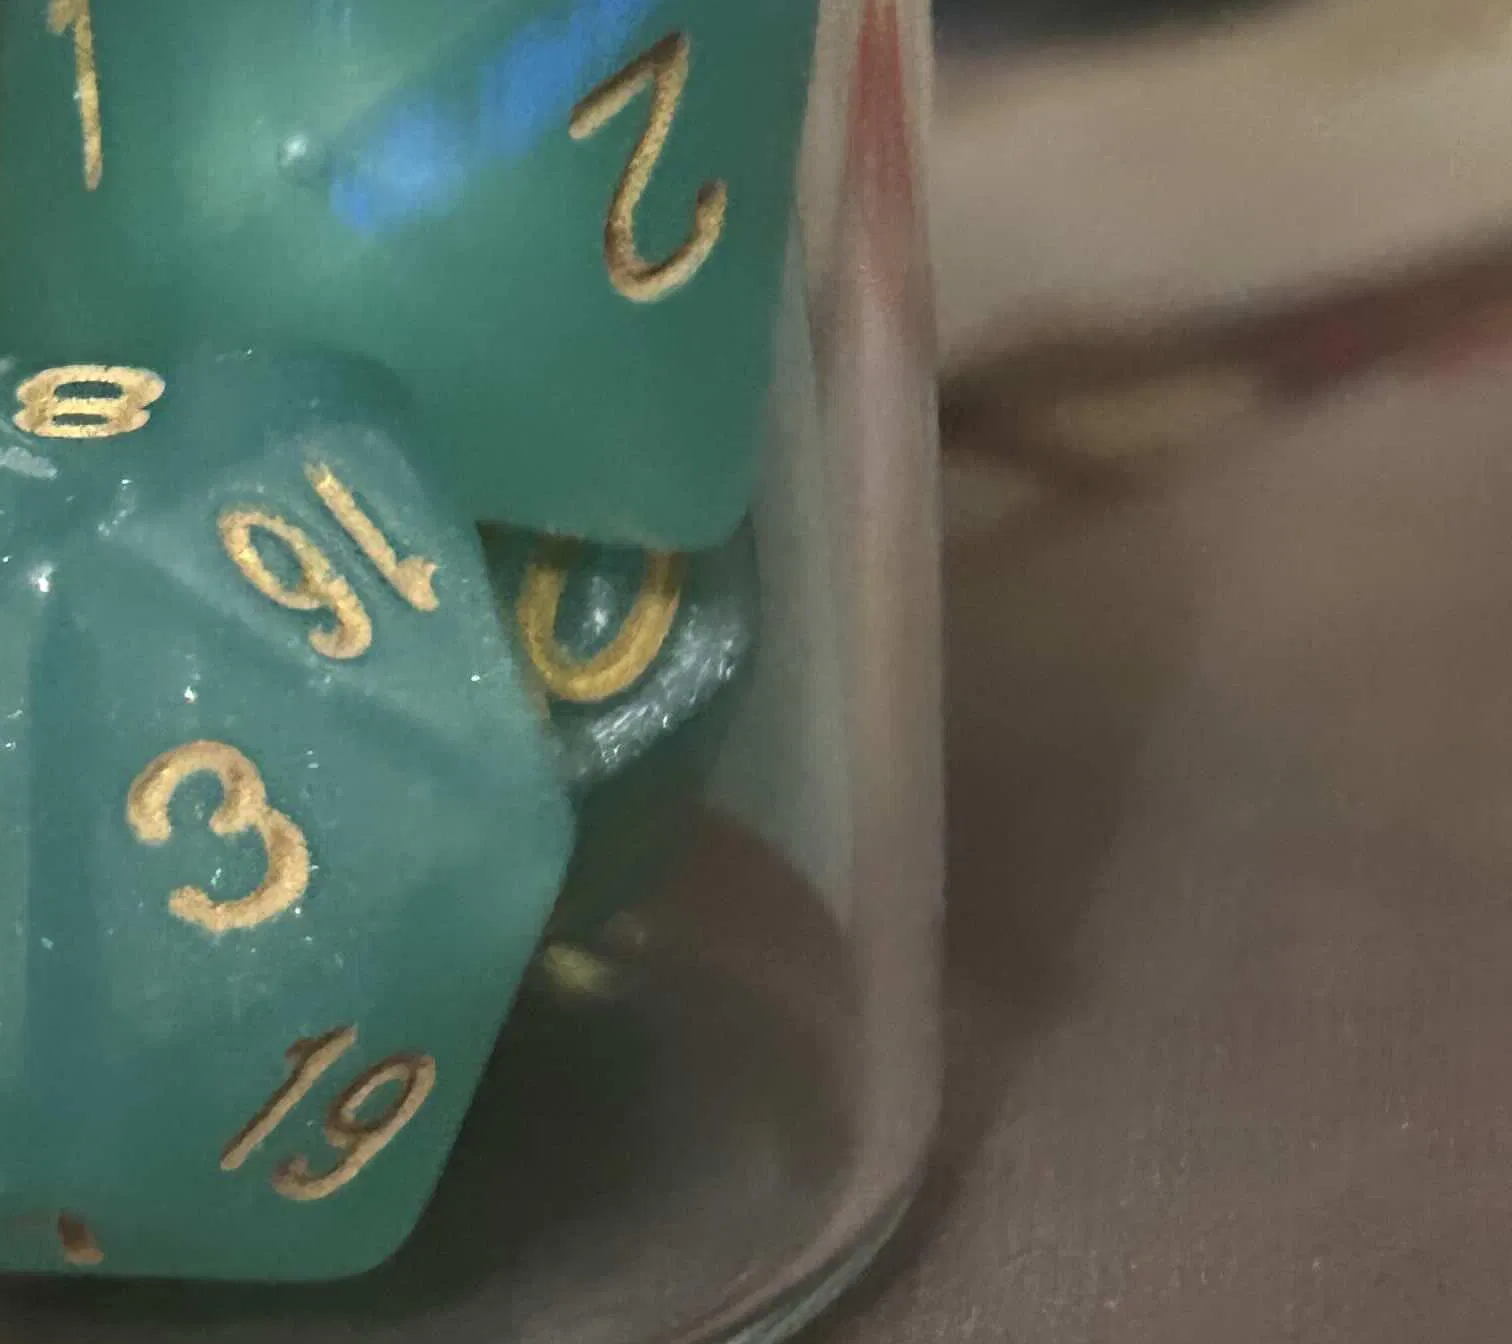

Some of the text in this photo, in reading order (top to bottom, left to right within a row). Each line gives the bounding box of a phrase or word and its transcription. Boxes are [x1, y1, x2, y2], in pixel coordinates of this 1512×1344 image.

[568, 32, 728, 304] 2
[14, 364, 166, 439] 8
[217, 461, 440, 660] 16
[126, 739, 310, 934] 3
[218, 1024, 438, 1201] 19
